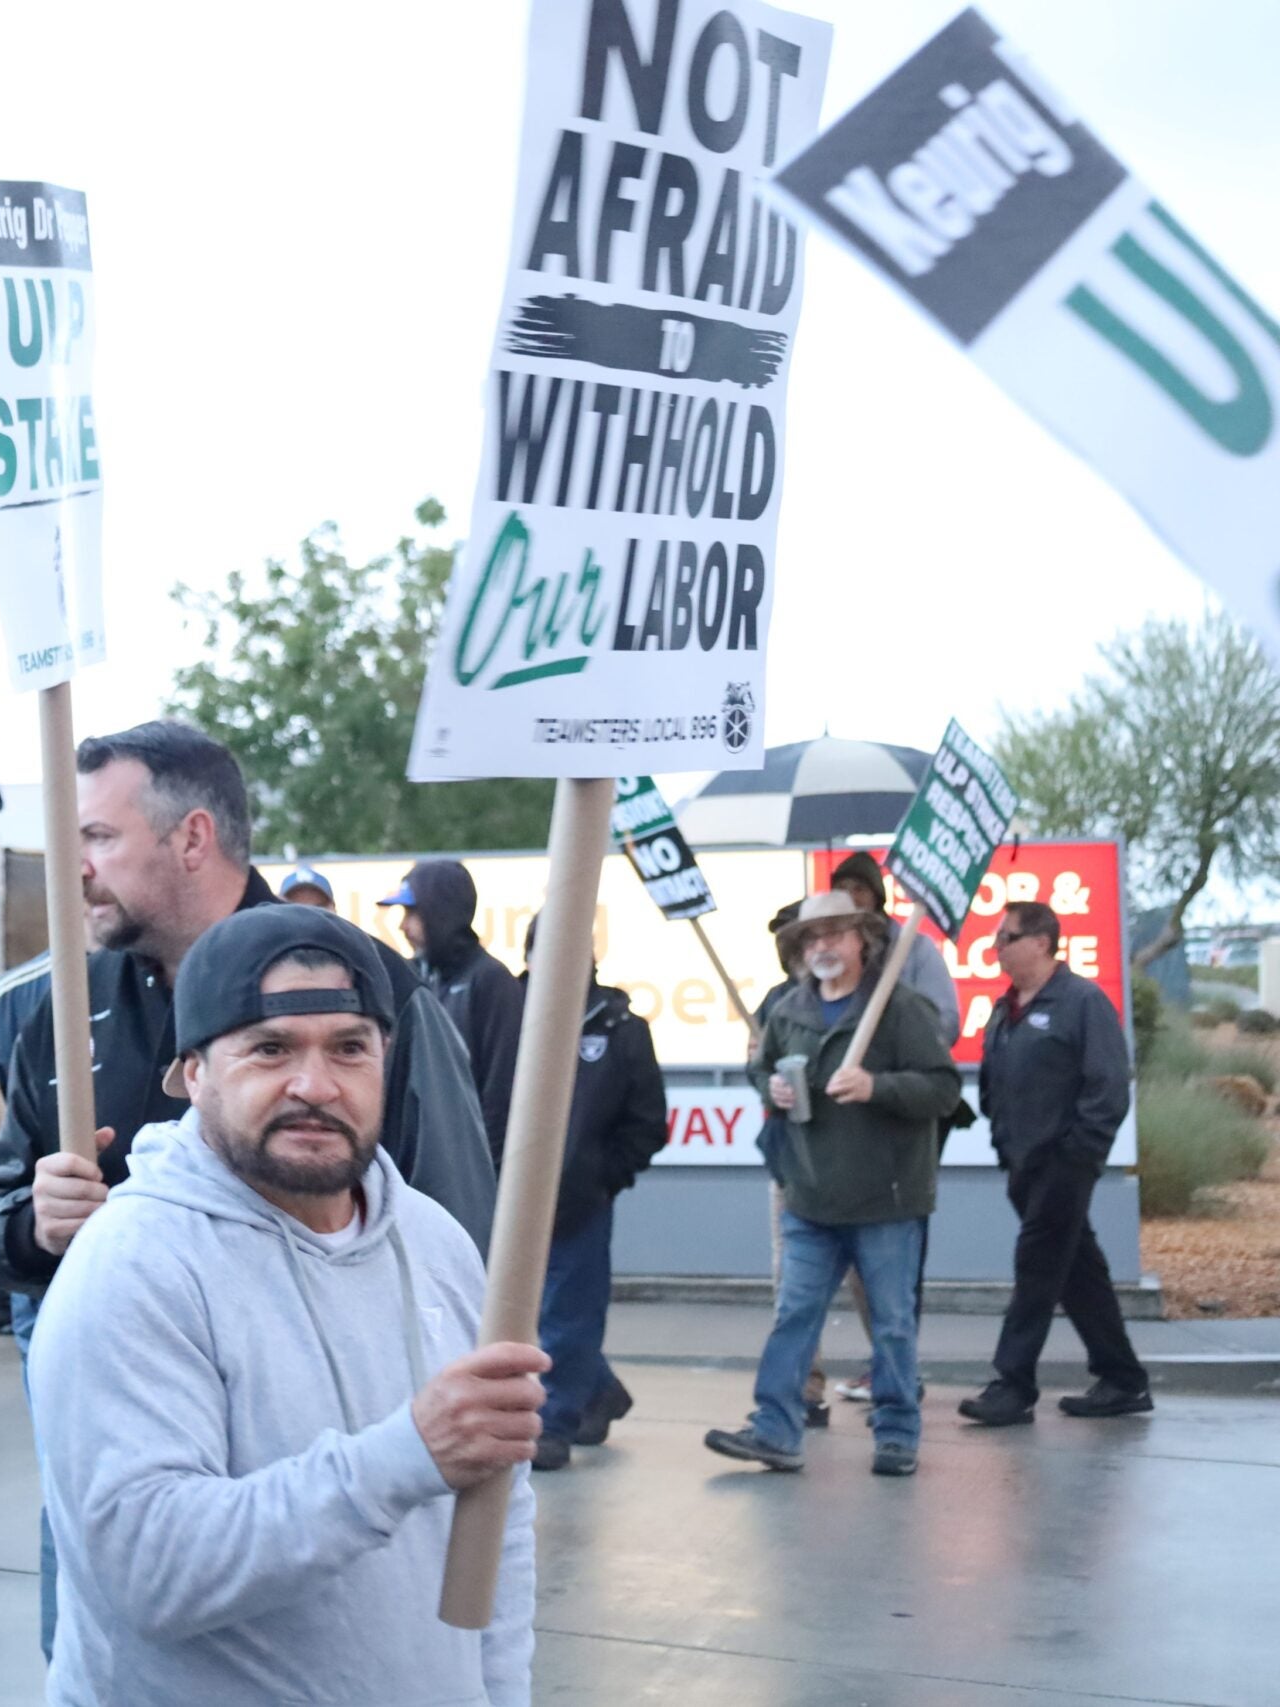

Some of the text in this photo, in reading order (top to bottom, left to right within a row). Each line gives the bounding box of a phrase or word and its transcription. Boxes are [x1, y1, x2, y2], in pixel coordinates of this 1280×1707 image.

[580, 0, 802, 168] NOT
[32, 197, 54, 240] Dr
[525, 128, 798, 316] AFRAID
[823, 77, 1074, 278] Keurig
[658, 317, 695, 372] TO
[491, 369, 776, 520] WITHHOLD
[453, 510, 765, 689] Our LABOR
[533, 715, 718, 743] TEAMSTERS LOCAL 896
[925, 779, 989, 866] RESPECT
[933, 745, 1006, 846] ULP STRIKE
[629, 836, 682, 879] NO
[899, 826, 970, 920] WORKERS
[928, 817, 972, 880] YOUR
